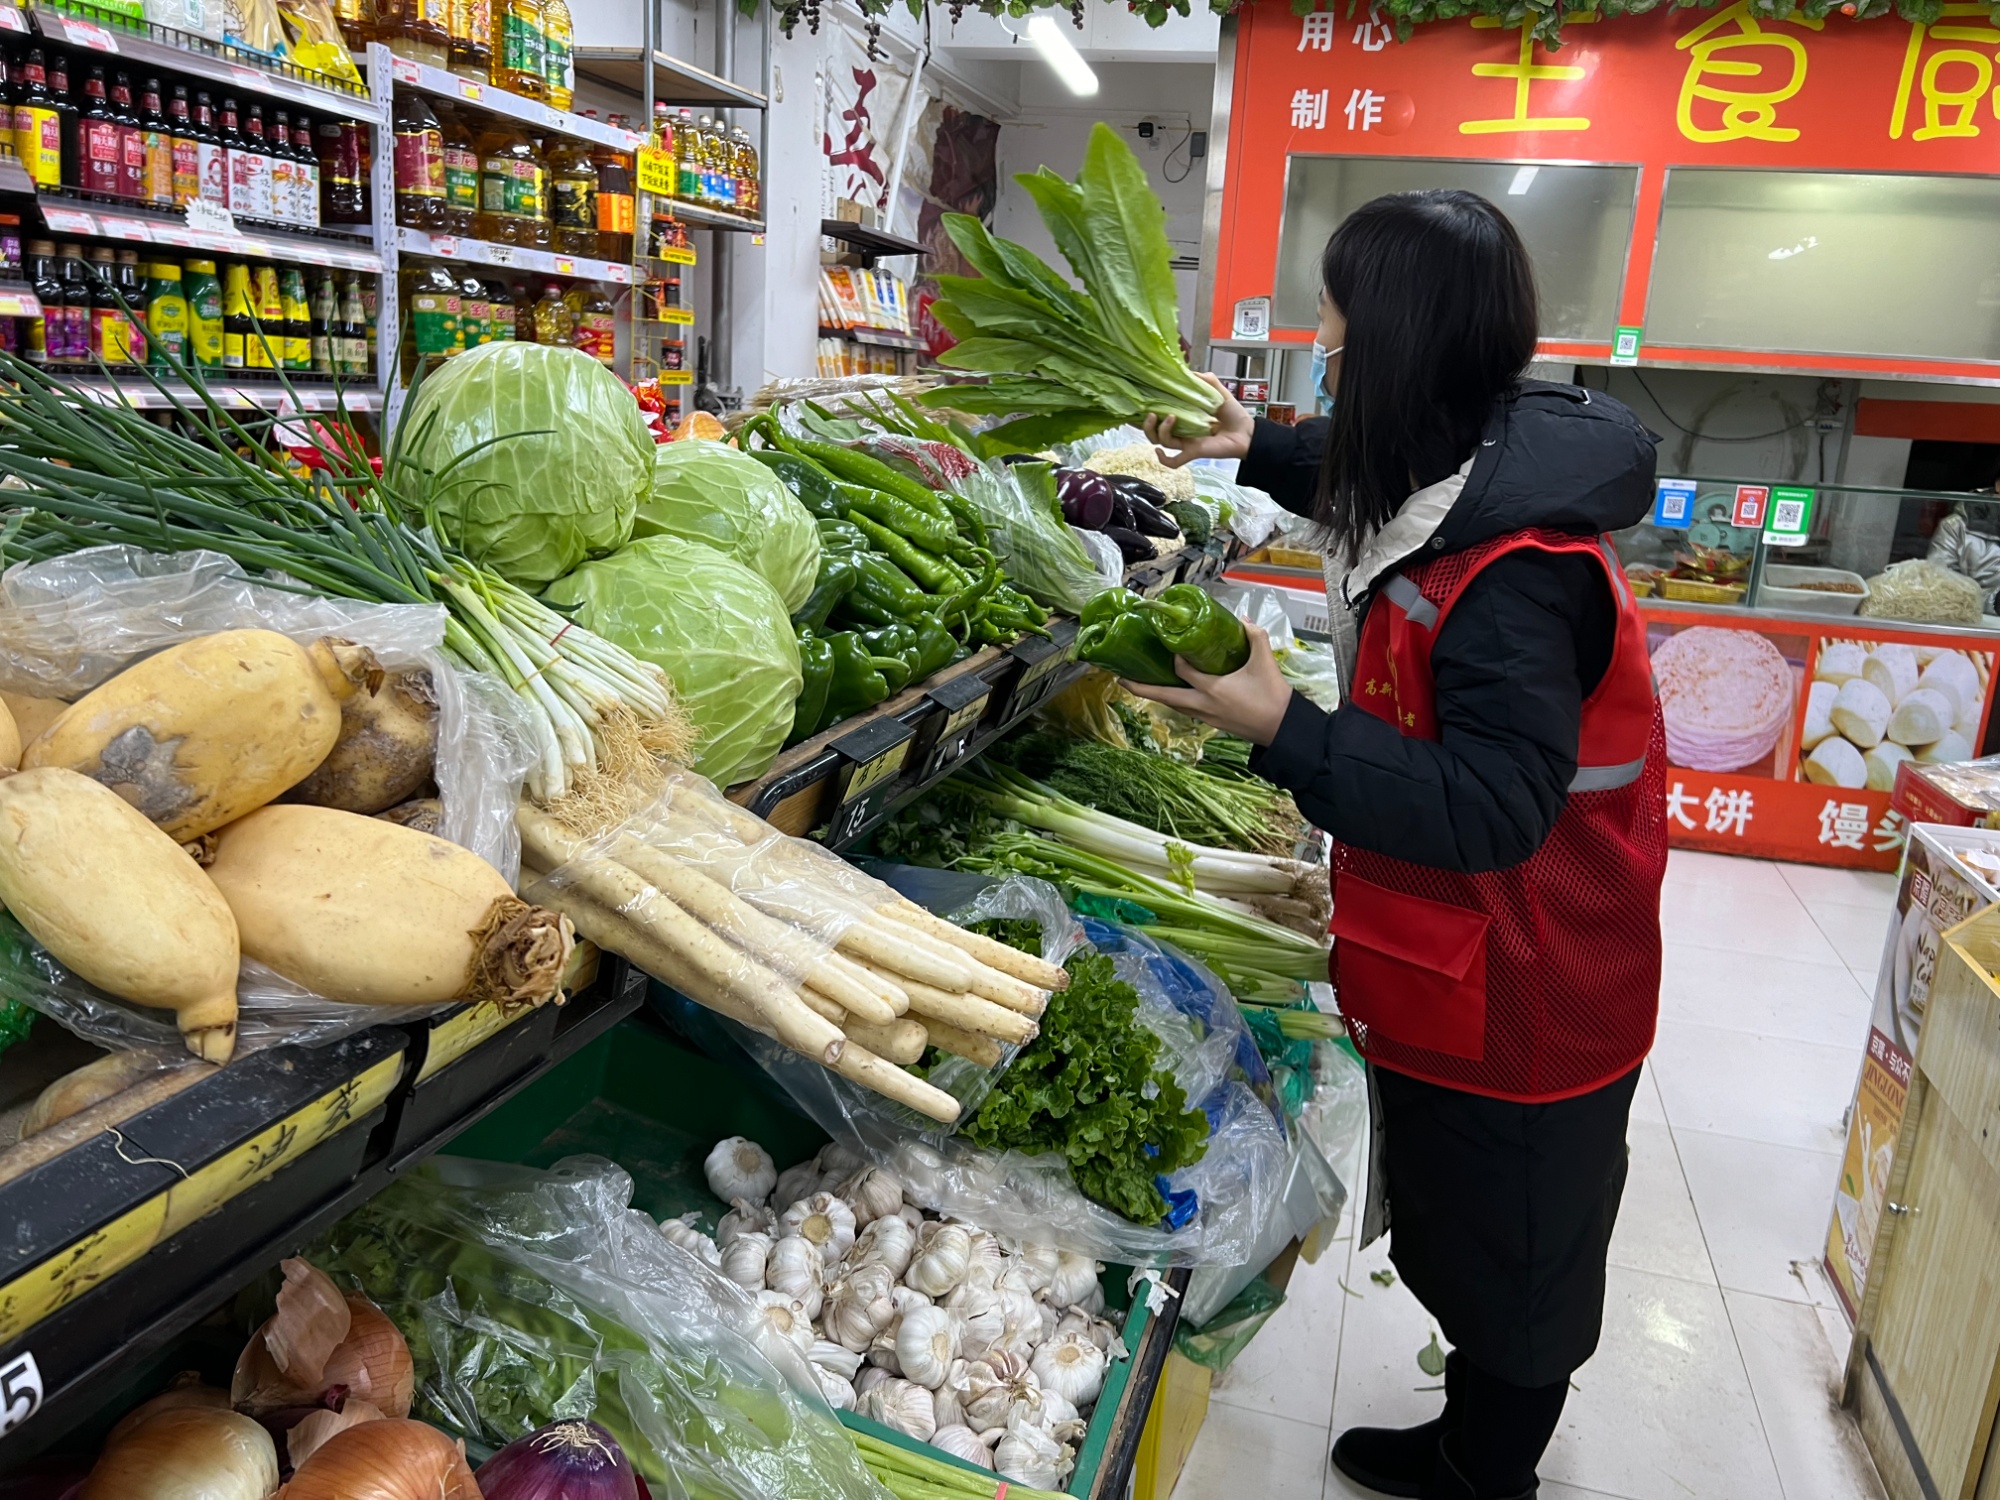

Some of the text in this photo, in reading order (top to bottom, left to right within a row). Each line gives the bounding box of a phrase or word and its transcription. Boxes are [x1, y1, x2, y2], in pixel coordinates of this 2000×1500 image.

[1296, 9, 1393, 52] 用心
[1290, 88, 1386, 131] 制作
[1666, 782, 1755, 836] 大饼
[1916, 963, 1932, 987] Cak
[0, 1361, 38, 1431] 5
